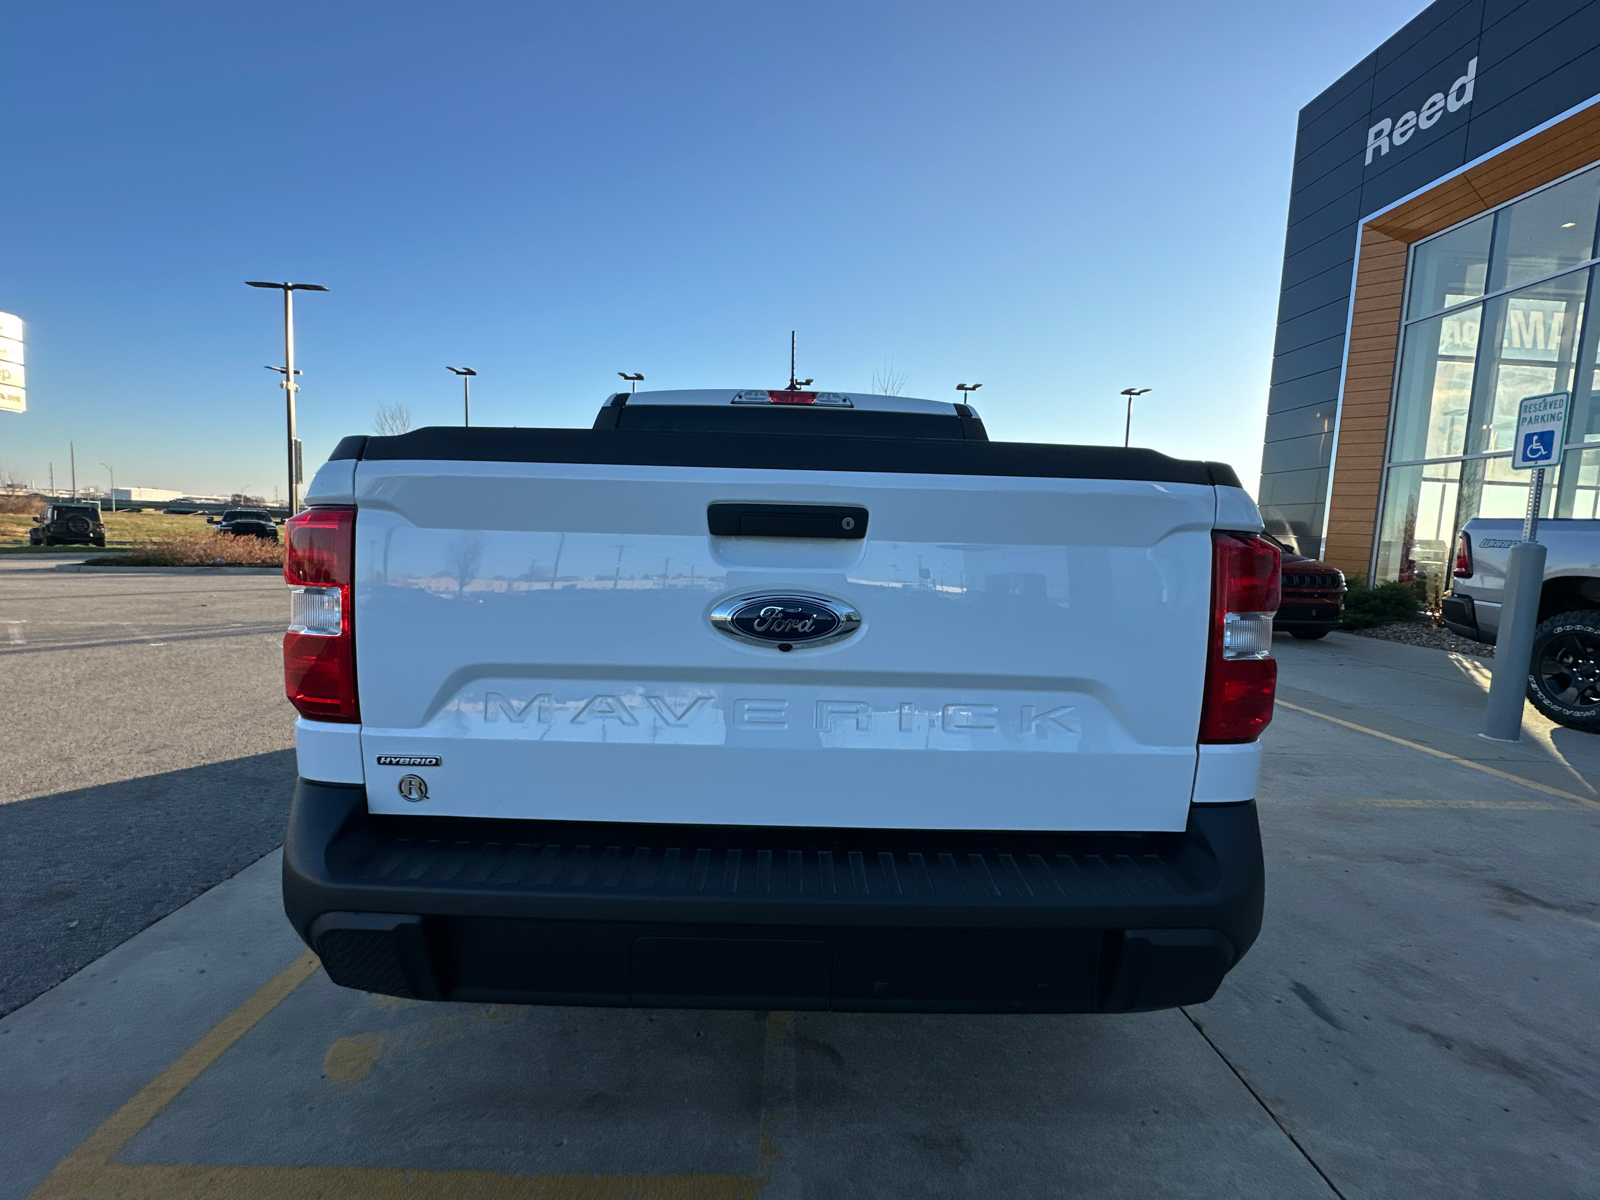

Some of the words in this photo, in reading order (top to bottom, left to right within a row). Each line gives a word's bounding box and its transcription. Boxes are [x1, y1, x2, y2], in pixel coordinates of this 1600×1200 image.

[1364, 55, 1479, 167] Reed
[1522, 398, 1564, 414] RESERVED
[1521, 411, 1563, 426] PARKING
[753, 606, 818, 633] Ford
[484, 692, 1077, 735] MAVERICK
[379, 757, 437, 765] HYBRID
